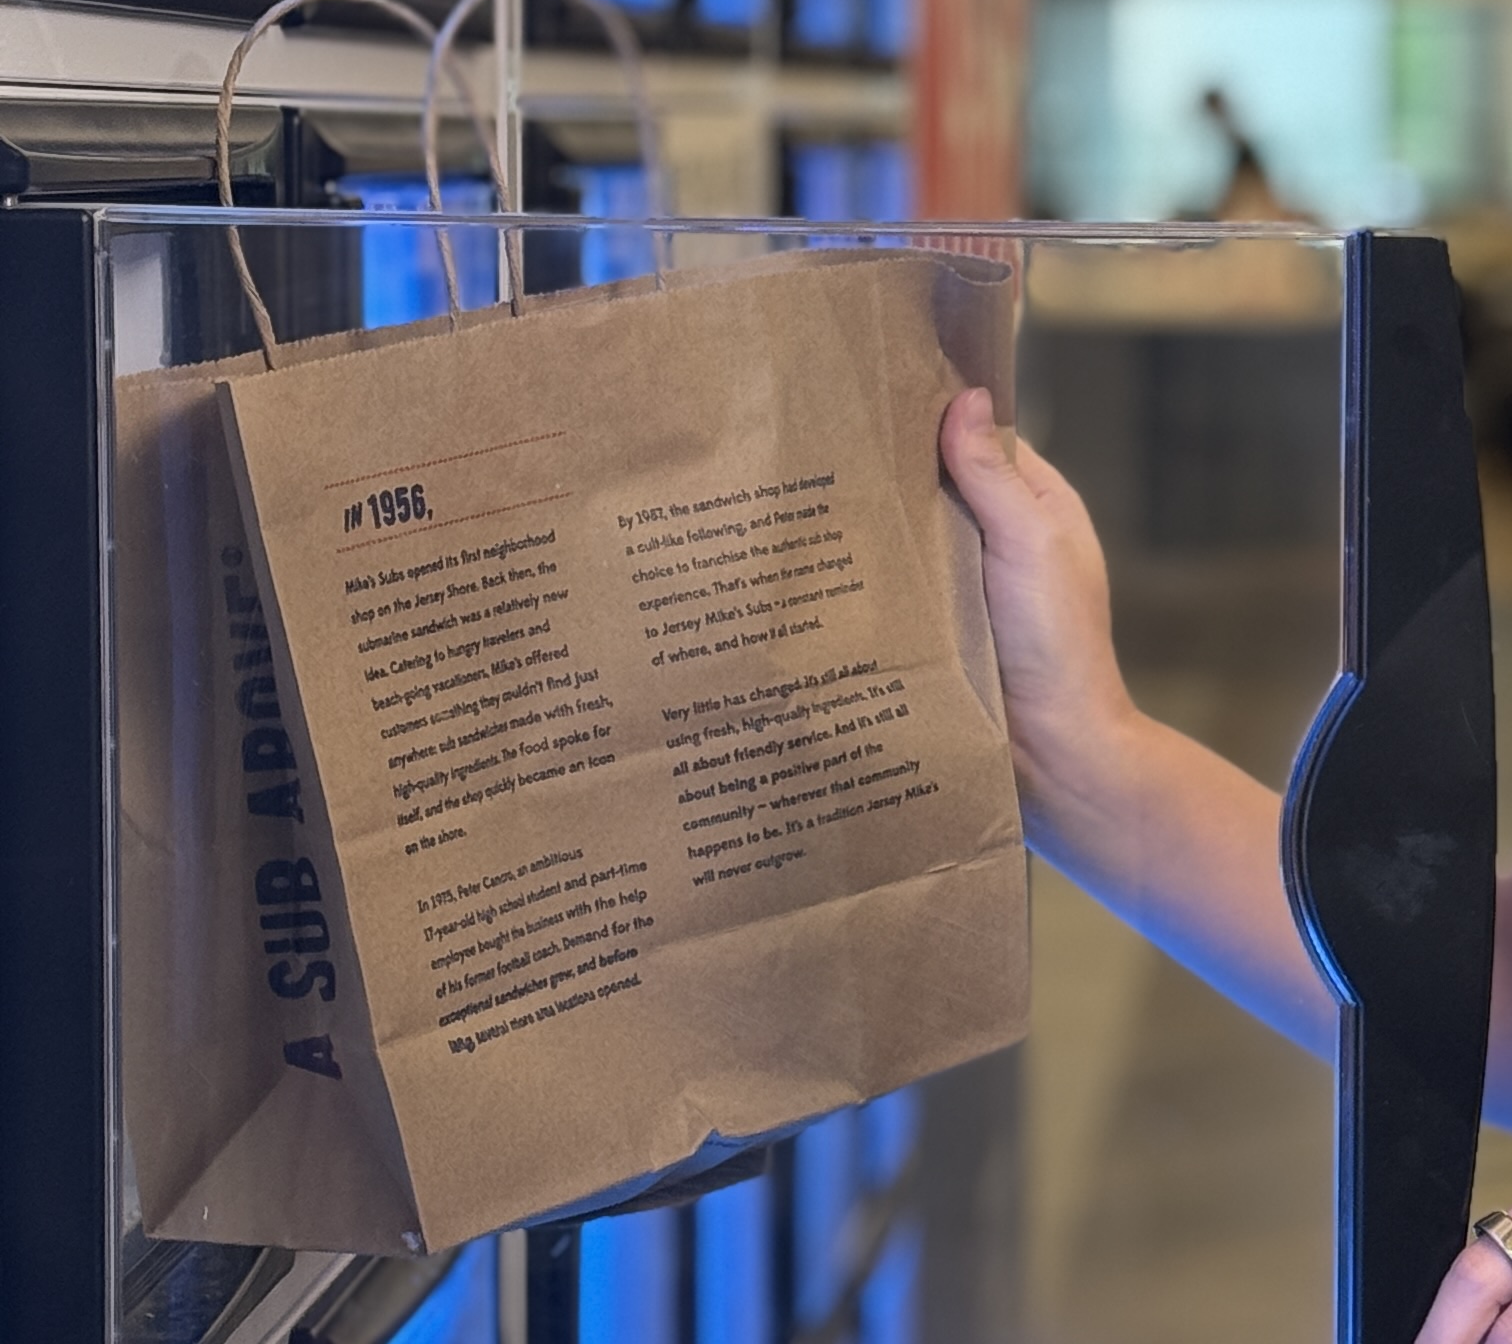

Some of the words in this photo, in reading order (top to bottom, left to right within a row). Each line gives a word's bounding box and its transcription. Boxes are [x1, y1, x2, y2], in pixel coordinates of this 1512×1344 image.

[344, 501, 363, 534] IN
[366, 483, 434, 530] 1956,
[618, 516, 633, 531] By
[669, 504, 689, 517] the
[693, 489, 751, 512] sandwich
[754, 485, 780, 499] shop
[378, 569, 405, 585] Subs
[407, 556, 443, 581] opened
[445, 556, 459, 568] its
[461, 548, 480, 564] first
[483, 529, 555, 560] neighborhood
[626, 547, 635, 555] a
[637, 534, 684, 553] cult-like
[750, 513, 772, 529] and
[632, 567, 674, 583] choice
[676, 563, 689, 573] to
[692, 551, 747, 569] franchise
[750, 545, 769, 557] the
[351, 609, 375, 624] shop
[377, 605, 391, 617] on
[393, 598, 411, 612] the
[415, 591, 445, 608] Jersey
[447, 582, 479, 598] Shore.
[481, 572, 506, 589] Back
[538, 562, 556, 574] the
[639, 589, 711, 611] experience.
[712, 577, 747, 594] That's
[749, 572, 779, 586] when
[358, 631, 408, 653] submarine
[411, 614, 458, 638] sandwich
[460, 611, 481, 624] was
[484, 609, 490, 618] a
[493, 594, 539, 616] relatively
[543, 590, 568, 602] new
[645, 628, 659, 639] to
[663, 618, 701, 635] Jersey
[705, 607, 744, 625] Mike's
[746, 601, 772, 616] Subs
[390, 655, 433, 674] Catering
[434, 650, 445, 662] to
[447, 641, 480, 658] hungry
[528, 619, 550, 636] and
[491, 657, 522, 675] Mike's
[525, 644, 569, 666] offered
[652, 651, 664, 666] of
[668, 646, 711, 662] where,
[715, 635, 739, 652] and
[741, 632, 768, 646] how
[479, 695, 500, 709] they
[502, 681, 543, 702] couldn't
[547, 673, 571, 690] find
[574, 669, 598, 689] just
[509, 711, 541, 729] made
[544, 704, 574, 719] with
[576, 695, 613, 713] fresh,
[662, 708, 690, 721] Very
[693, 699, 720, 714] little
[723, 695, 746, 707] has
[519, 737, 549, 756] food
[553, 730, 590, 751] spoke
[593, 725, 611, 739] for
[666, 733, 701, 749] using
[703, 722, 739, 739] fresh,
[742, 705, 810, 733] high-quality
[867, 686, 885, 698] It's
[673, 761, 689, 776] all
[693, 753, 730, 772] about
[734, 741, 783, 762] friendly
[788, 731, 832, 749] service.
[835, 719, 856, 736] And
[857, 716, 873, 729] it's
[875, 708, 894, 723] still
[895, 704, 909, 717] all
[425, 800, 443, 818] and
[445, 797, 459, 809] the
[462, 791, 483, 805] shop
[485, 777, 515, 799] quickly
[517, 766, 565, 786] became
[569, 761, 585, 773] an
[588, 754, 615, 768] icon
[679, 784, 715, 804] about
[718, 777, 757, 794] being
[760, 775, 768, 785] a
[771, 762, 819, 785] positive
[823, 752, 847, 771] part
[850, 746, 861, 760] of
[865, 743, 883, 756] the
[683, 806, 754, 831] community
[769, 787, 826, 809] wherever
[831, 777, 854, 793] that
[858, 761, 920, 785] community
[405, 843, 418, 855] on
[420, 836, 436, 849] the
[438, 828, 466, 844] shore.
[687, 837, 743, 859] happens
[747, 832, 759, 844] to
[763, 827, 782, 839] be.
[786, 820, 803, 834] It's
[807, 819, 814, 828] a
[867, 795, 902, 811] Jersey
[417, 900, 429, 913] In
[530, 849, 583, 872] ambitious
[692, 869, 715, 886] will
[718, 863, 751, 879] never
[424, 912, 475, 942] 17-year-old
[476, 905, 497, 924] high
[499, 893, 525, 915] school
[527, 881, 561, 904] student
[564, 873, 587, 891] and
[591, 862, 647, 887] part-time
[254, 855, 338, 1004] SUB
[431, 946, 476, 970] employee
[477, 931, 510, 953] bought
[566, 901, 592, 919] with
[619, 889, 647, 905] help
[436, 982, 446, 998] of
[448, 980, 462, 993] his
[562, 924, 609, 950] Demand
[612, 921, 630, 935] for
[633, 917, 654, 929] the
[577, 956, 596, 975] and
[599, 949, 638, 967] before
[282, 1032, 343, 1082] A
